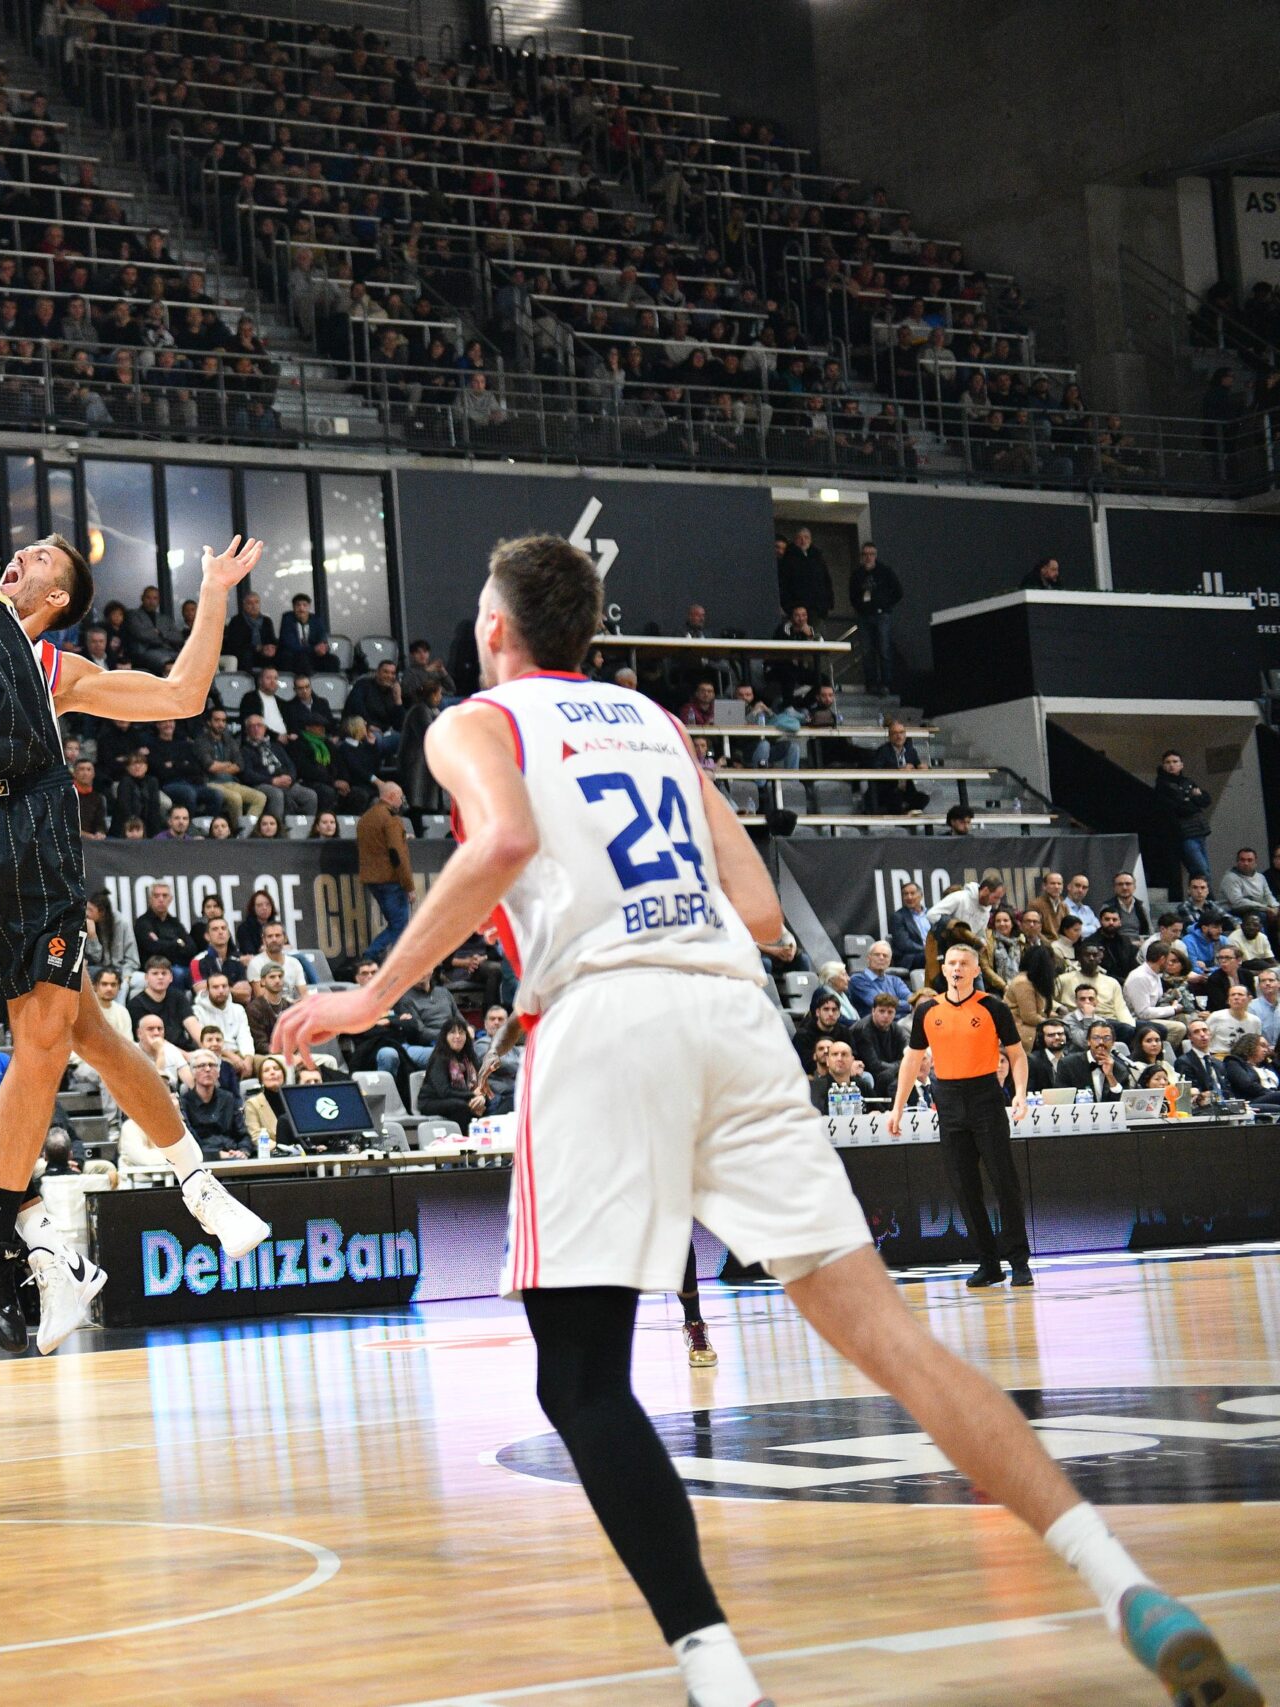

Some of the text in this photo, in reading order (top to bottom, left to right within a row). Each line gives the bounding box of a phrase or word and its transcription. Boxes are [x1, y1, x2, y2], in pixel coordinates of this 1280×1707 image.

[576, 772, 709, 891] 24
[70, 930, 87, 973] 7
[85, 1148, 93, 1158] C
